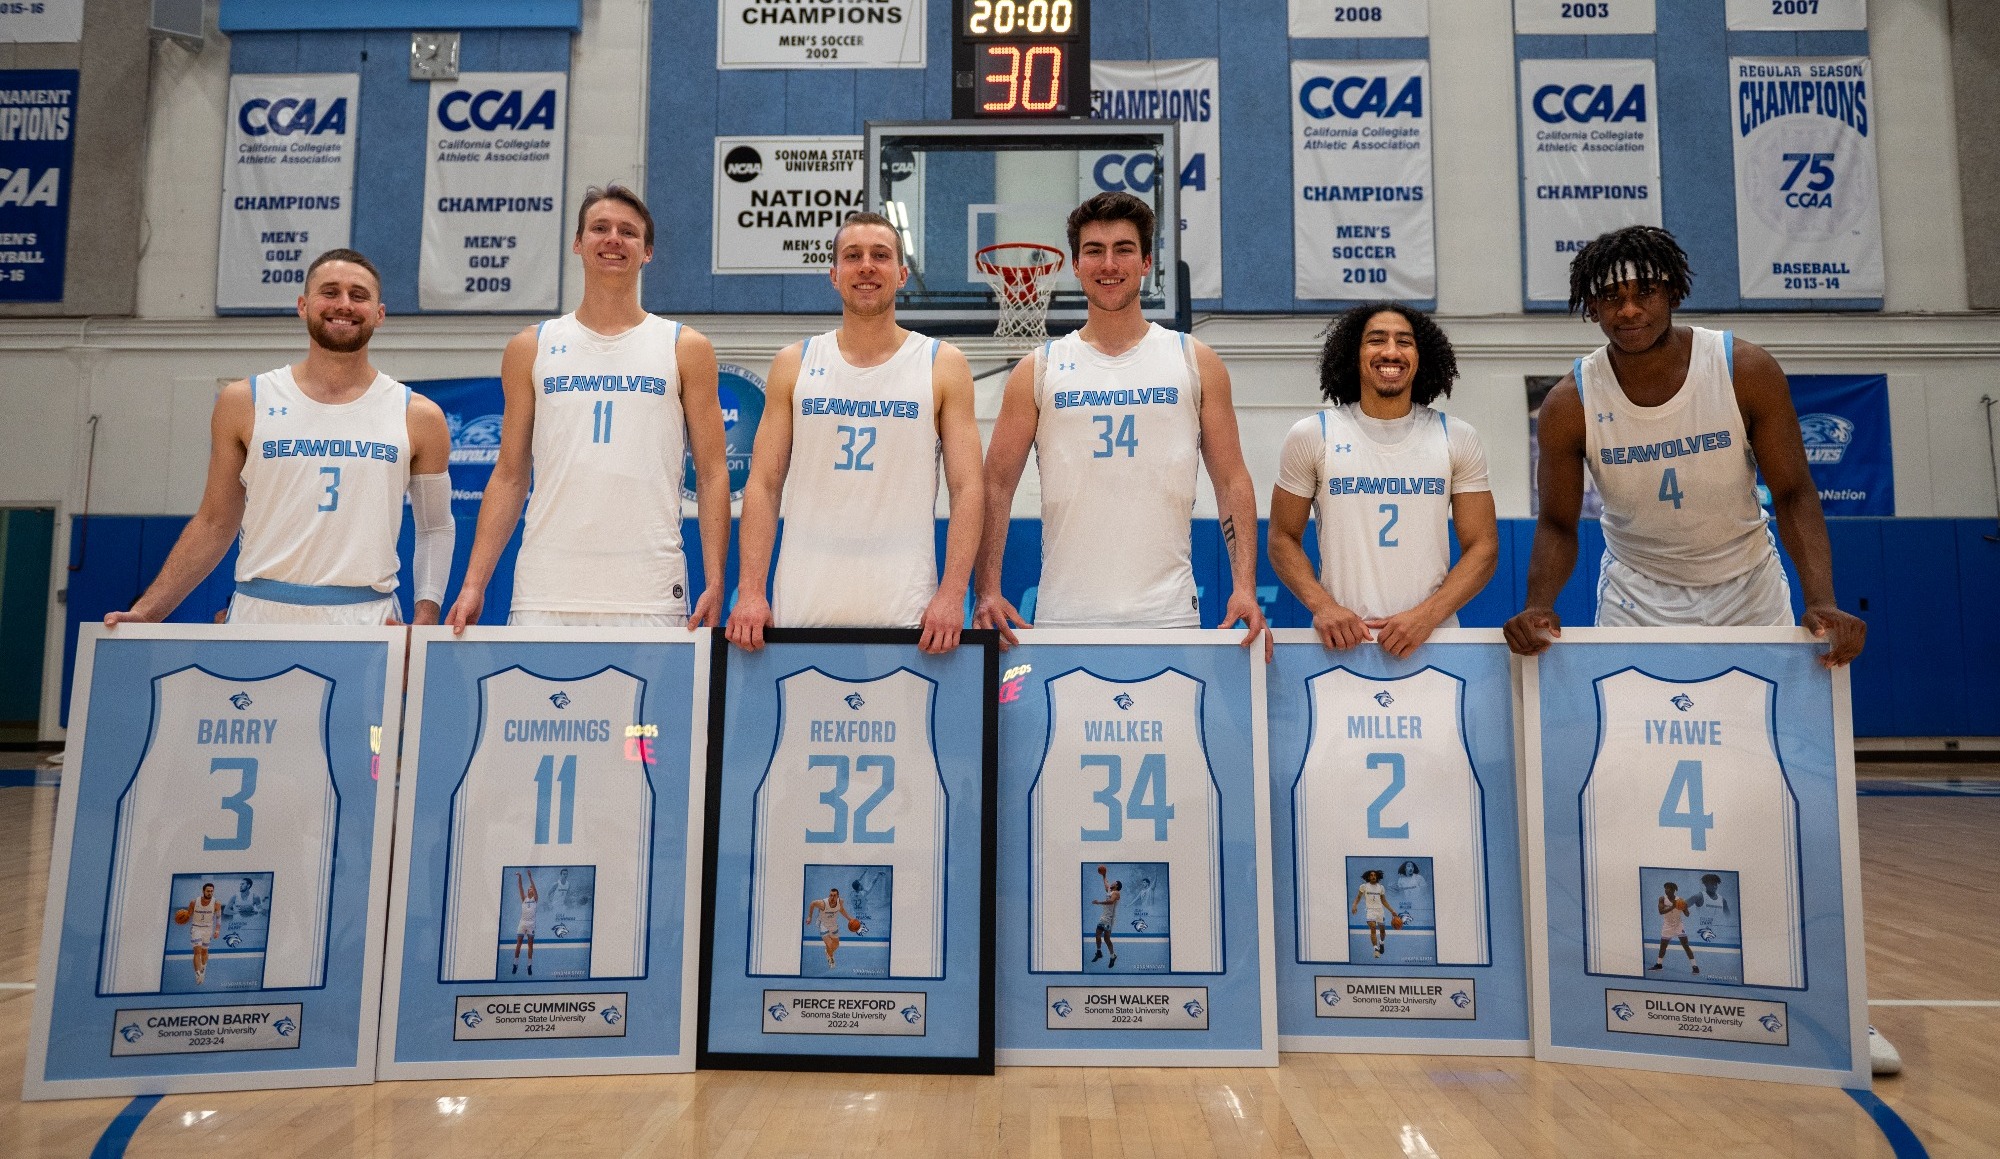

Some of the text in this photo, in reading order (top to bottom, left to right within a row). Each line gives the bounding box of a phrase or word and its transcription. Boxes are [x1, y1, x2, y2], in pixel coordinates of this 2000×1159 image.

[742, 6, 902, 24] CHAMPIONS
[1335, 7, 1382, 22] 2008
[1561, 3, 1609, 18] 2003
[1773, 0, 1819, 15] 2007
[970, 0, 1072, 33] 20:00
[779, 35, 864, 46] MEN'S SOCCER
[806, 48, 839, 59] 2002
[984, 46, 1061, 111] 30
[1739, 65, 1863, 78] REGULAR SEASON
[0, 90, 71, 104] NAMENT
[1299, 75, 1423, 119] CCAA
[1532, 83, 1647, 124] CCAA
[238, 97, 347, 136] CCAA
[437, 89, 556, 131] CCAA
[1739, 81, 1868, 138] CHAMPIONS
[1304, 126, 1420, 138] California Collegiate
[1537, 130, 1644, 141] California Collegiate
[239, 142, 341, 154] California Collegiate
[438, 139, 550, 151] California Collegiate
[1303, 140, 1421, 150] Athletic Association
[1537, 142, 1645, 152] Athletic Association
[238, 154, 341, 164] Athletic Association
[437, 152, 550, 162] Athletic Association
[775, 150, 827, 160] SONOMA
[727, 163, 762, 174] NCAA
[785, 161, 854, 172] UNIVERSITY
[1780, 153, 1835, 192] 75
[750, 190, 863, 206] NATIONA
[1303, 186, 1424, 202] CHAMPIONS
[1537, 185, 1648, 200] CHAMPIONS
[234, 196, 340, 210] CHAMPIONS
[438, 197, 553, 212] CHAMPIONS
[1785, 192, 1833, 209] CCAA
[738, 210, 857, 228] CHAMPI
[261, 231, 308, 243] MEN'S
[1336, 225, 1391, 239] MEN'S
[464, 236, 516, 249] MEN'S
[782, 240, 821, 250] MEN'S
[266, 250, 302, 261] GOLF
[1332, 246, 1396, 259] SOCCER
[469, 256, 509, 268] GOLF
[1773, 262, 1850, 275] BASEBALL
[261, 269, 304, 283] 2008
[1343, 268, 1387, 283] 2010
[1785, 277, 1840, 289] 2013-14
[465, 277, 511, 292] 2009
[543, 375, 666, 395] SEAWOLVES
[1055, 387, 1178, 409] SEAWOLVES
[802, 398, 919, 419] SEAWOLVES
[592, 400, 613, 443] 11
[1092, 414, 1138, 459] 34
[263, 439, 399, 463] SEAWOLVES
[834, 425, 877, 471] 32
[1601, 430, 1732, 464] SEAWOLVES
[318, 466, 341, 512] 3
[1329, 476, 1445, 495] SEAWOLVES
[1658, 467, 1683, 509] 4
[1378, 503, 1398, 547] 2
[197, 719, 278, 744] BARRY
[504, 719, 610, 742] CUMMINGS
[810, 720, 896, 742] REXFORD
[1084, 720, 1163, 742] WALKER
[1347, 715, 1422, 739] MILLER
[1645, 720, 1721, 745] IYAWE
[534, 755, 577, 844] 11
[805, 755, 895, 843] 32
[1081, 753, 1175, 841] 34
[1366, 753, 1409, 839] 2
[203, 757, 259, 851] 3
[1659, 760, 1713, 851] 4
[1347, 984, 1442, 995] DAMIEN MILLER
[793, 998, 895, 1010] PIERCE REXFORD
[1085, 994, 1169, 1005] JOSH WALKER
[1383, 996, 1401, 1004] State
[1403, 997, 1437, 1006] University
[487, 1002, 596, 1014] COLE CUMMINGS
[1116, 1006, 1134, 1014] State
[1135, 1006, 1170, 1016] University
[1380, 1005, 1410, 1013] 2023-24
[1645, 999, 1745, 1017] DILLON IYAWE
[147, 1012, 270, 1028] CAMERON BARRY
[528, 1015, 548, 1023] State
[550, 1014, 586, 1023] University
[832, 1011, 850, 1019] State
[852, 1012, 887, 1021] University
[1647, 1012, 1743, 1027] Sonoma State University
[158, 1026, 257, 1037] Sonoma State University
[525, 1024, 555, 1032] 2021-24
[1678, 1023, 1713, 1033] 2022-24
[189, 1037, 224, 1046] 2023-24
